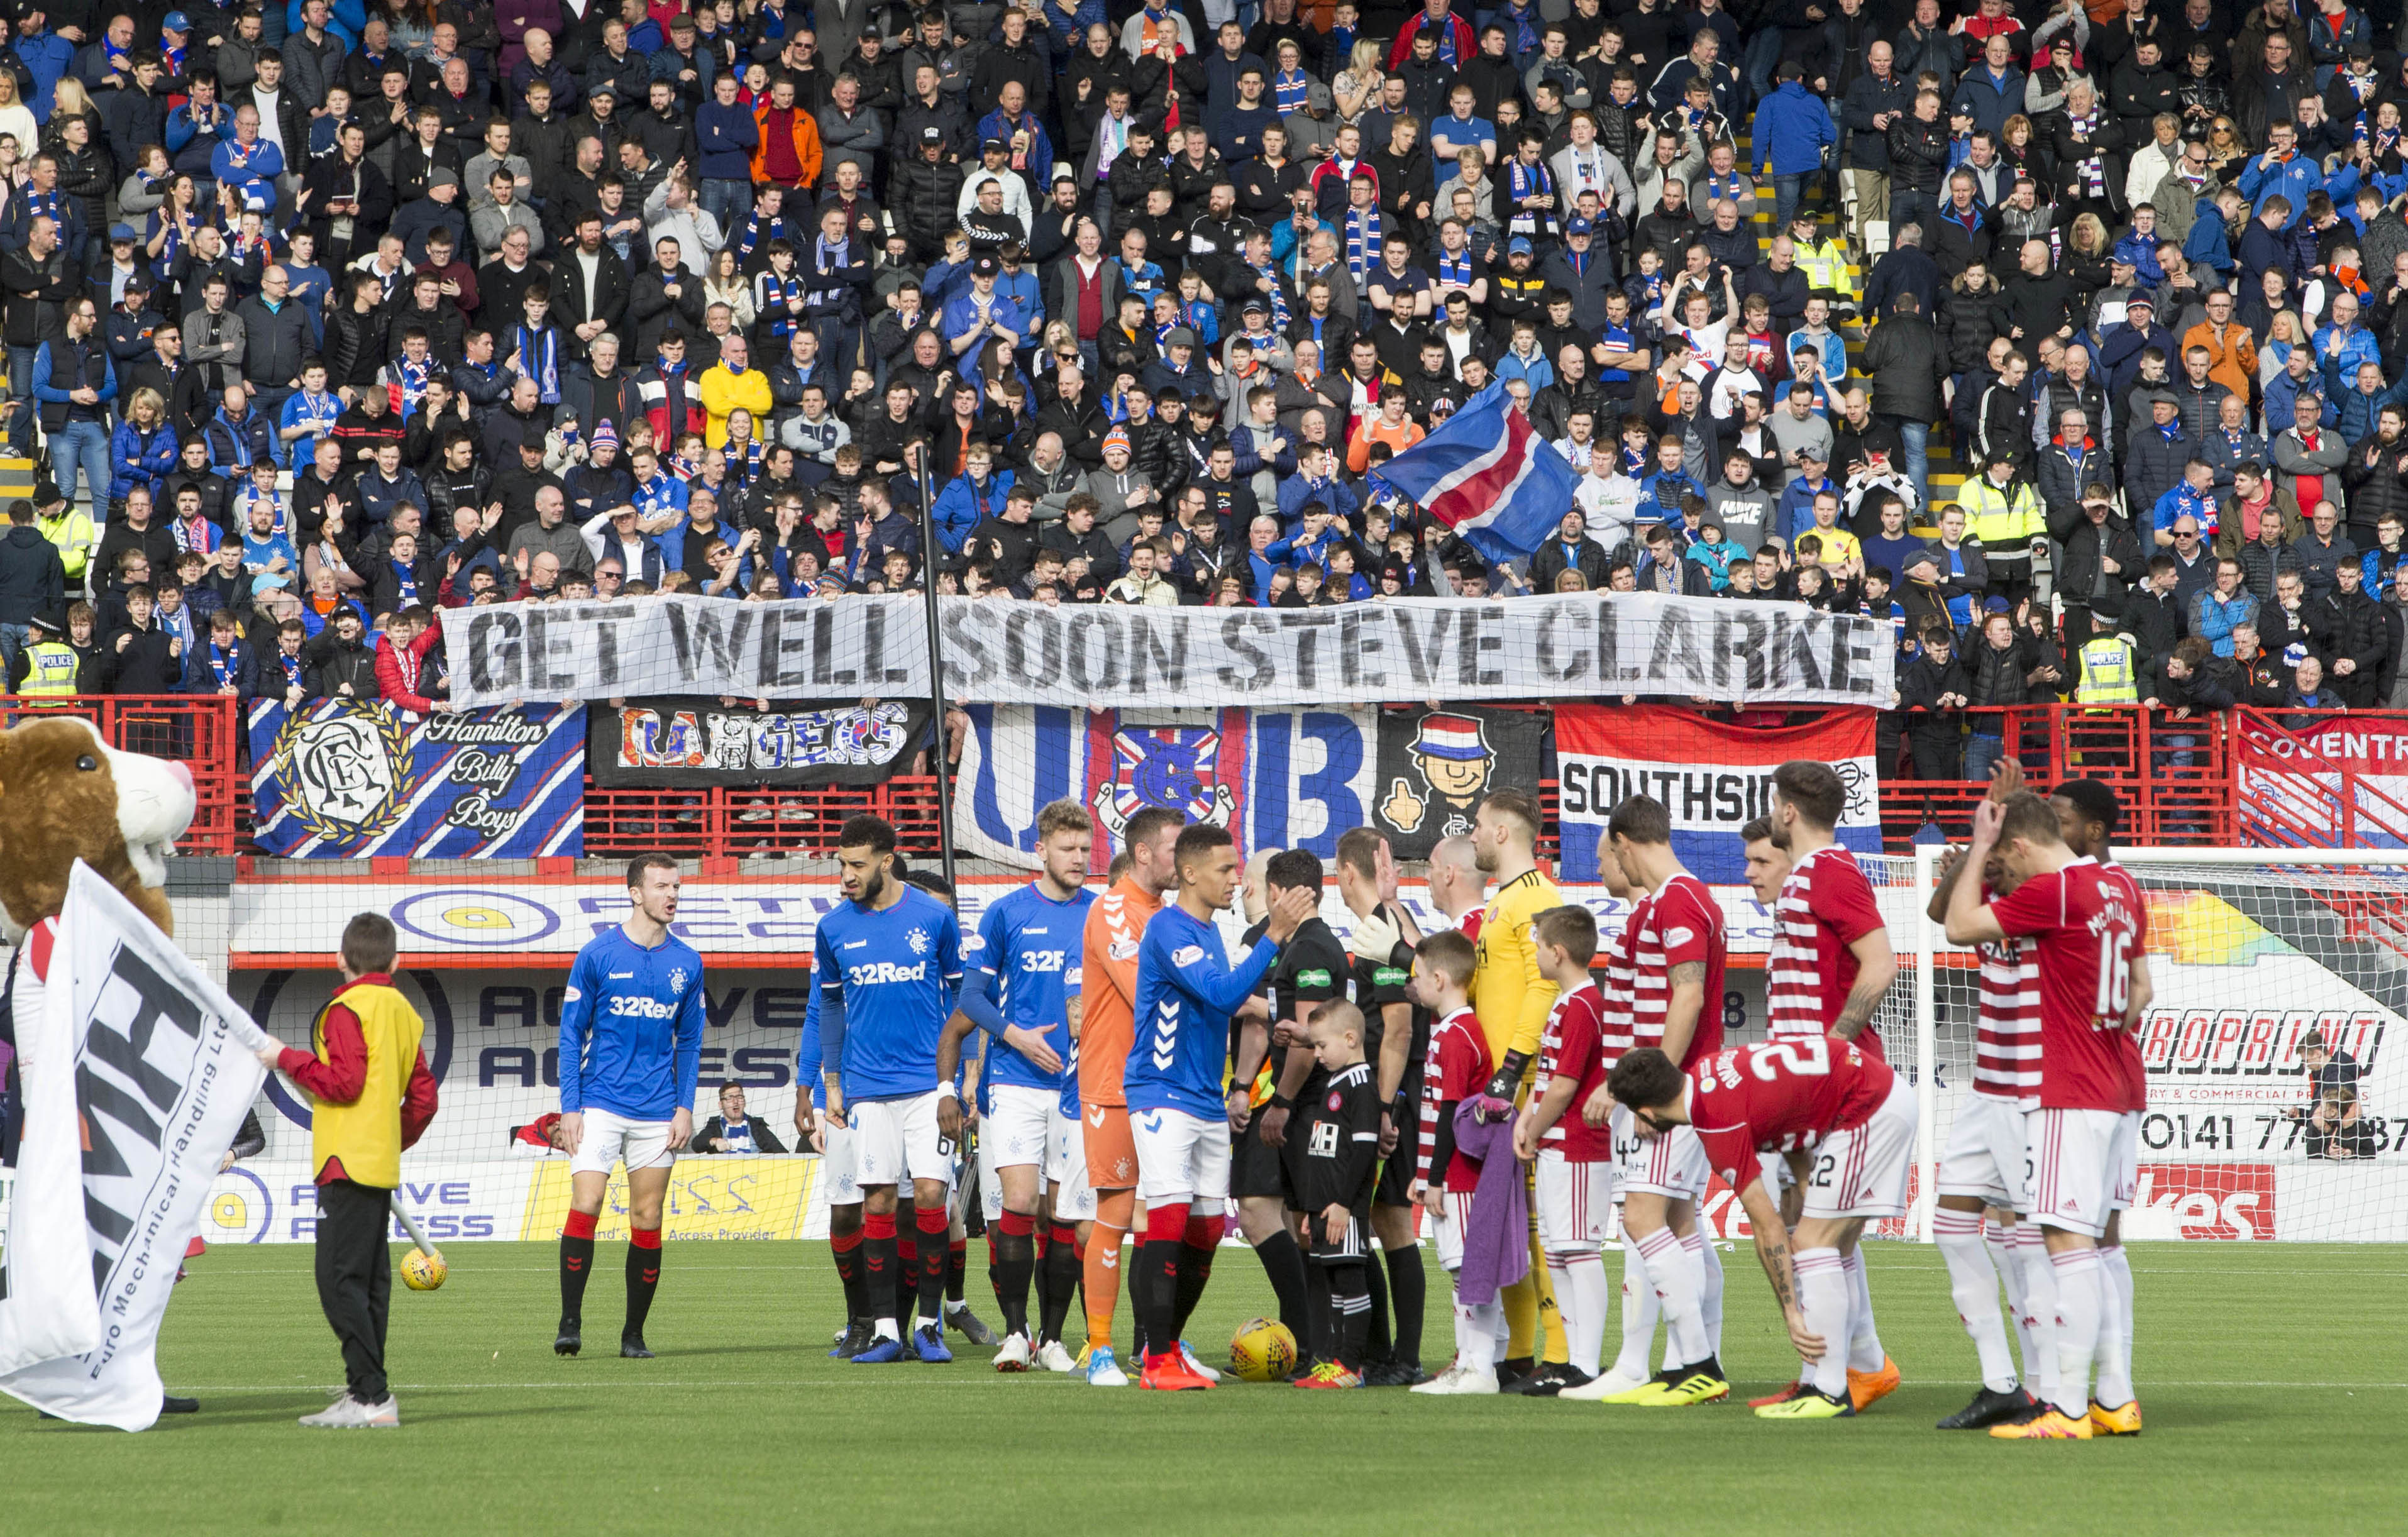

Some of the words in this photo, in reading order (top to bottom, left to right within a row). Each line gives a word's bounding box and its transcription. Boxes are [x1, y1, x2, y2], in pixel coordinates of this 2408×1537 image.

[1719, 500, 1762, 526] NIKE
[468, 604, 635, 693] GET
[666, 602, 909, 687] WELL
[942, 604, 1190, 694] SOON
[1217, 605, 1505, 691] STEVE
[1535, 599, 1874, 693] CLARKE
[2089, 651, 2124, 665] POLICE
[40, 655, 74, 667] POLICE
[425, 711, 543, 742] Hamilton
[618, 702, 907, 770] RANGERS
[451, 751, 516, 796] Billy
[448, 795, 518, 838] Boys
[849, 961, 926, 986] 32Red
[1021, 950, 1066, 972] 32R
[2096, 930, 2132, 1015] 16
[609, 996, 679, 1020] 32Red
[2189, 1089, 2287, 1100] COMMERCIAL
[2141, 1113, 2234, 1150] 0141
[90, 1325, 121, 1380] Euro
[113, 1172, 180, 1317] Mechanical
[169, 1062, 218, 1169] Handling
[210, 1014, 230, 1056] Ltd
[668, 1228, 713, 1241] Access
[719, 1228, 776, 1242] Provider
